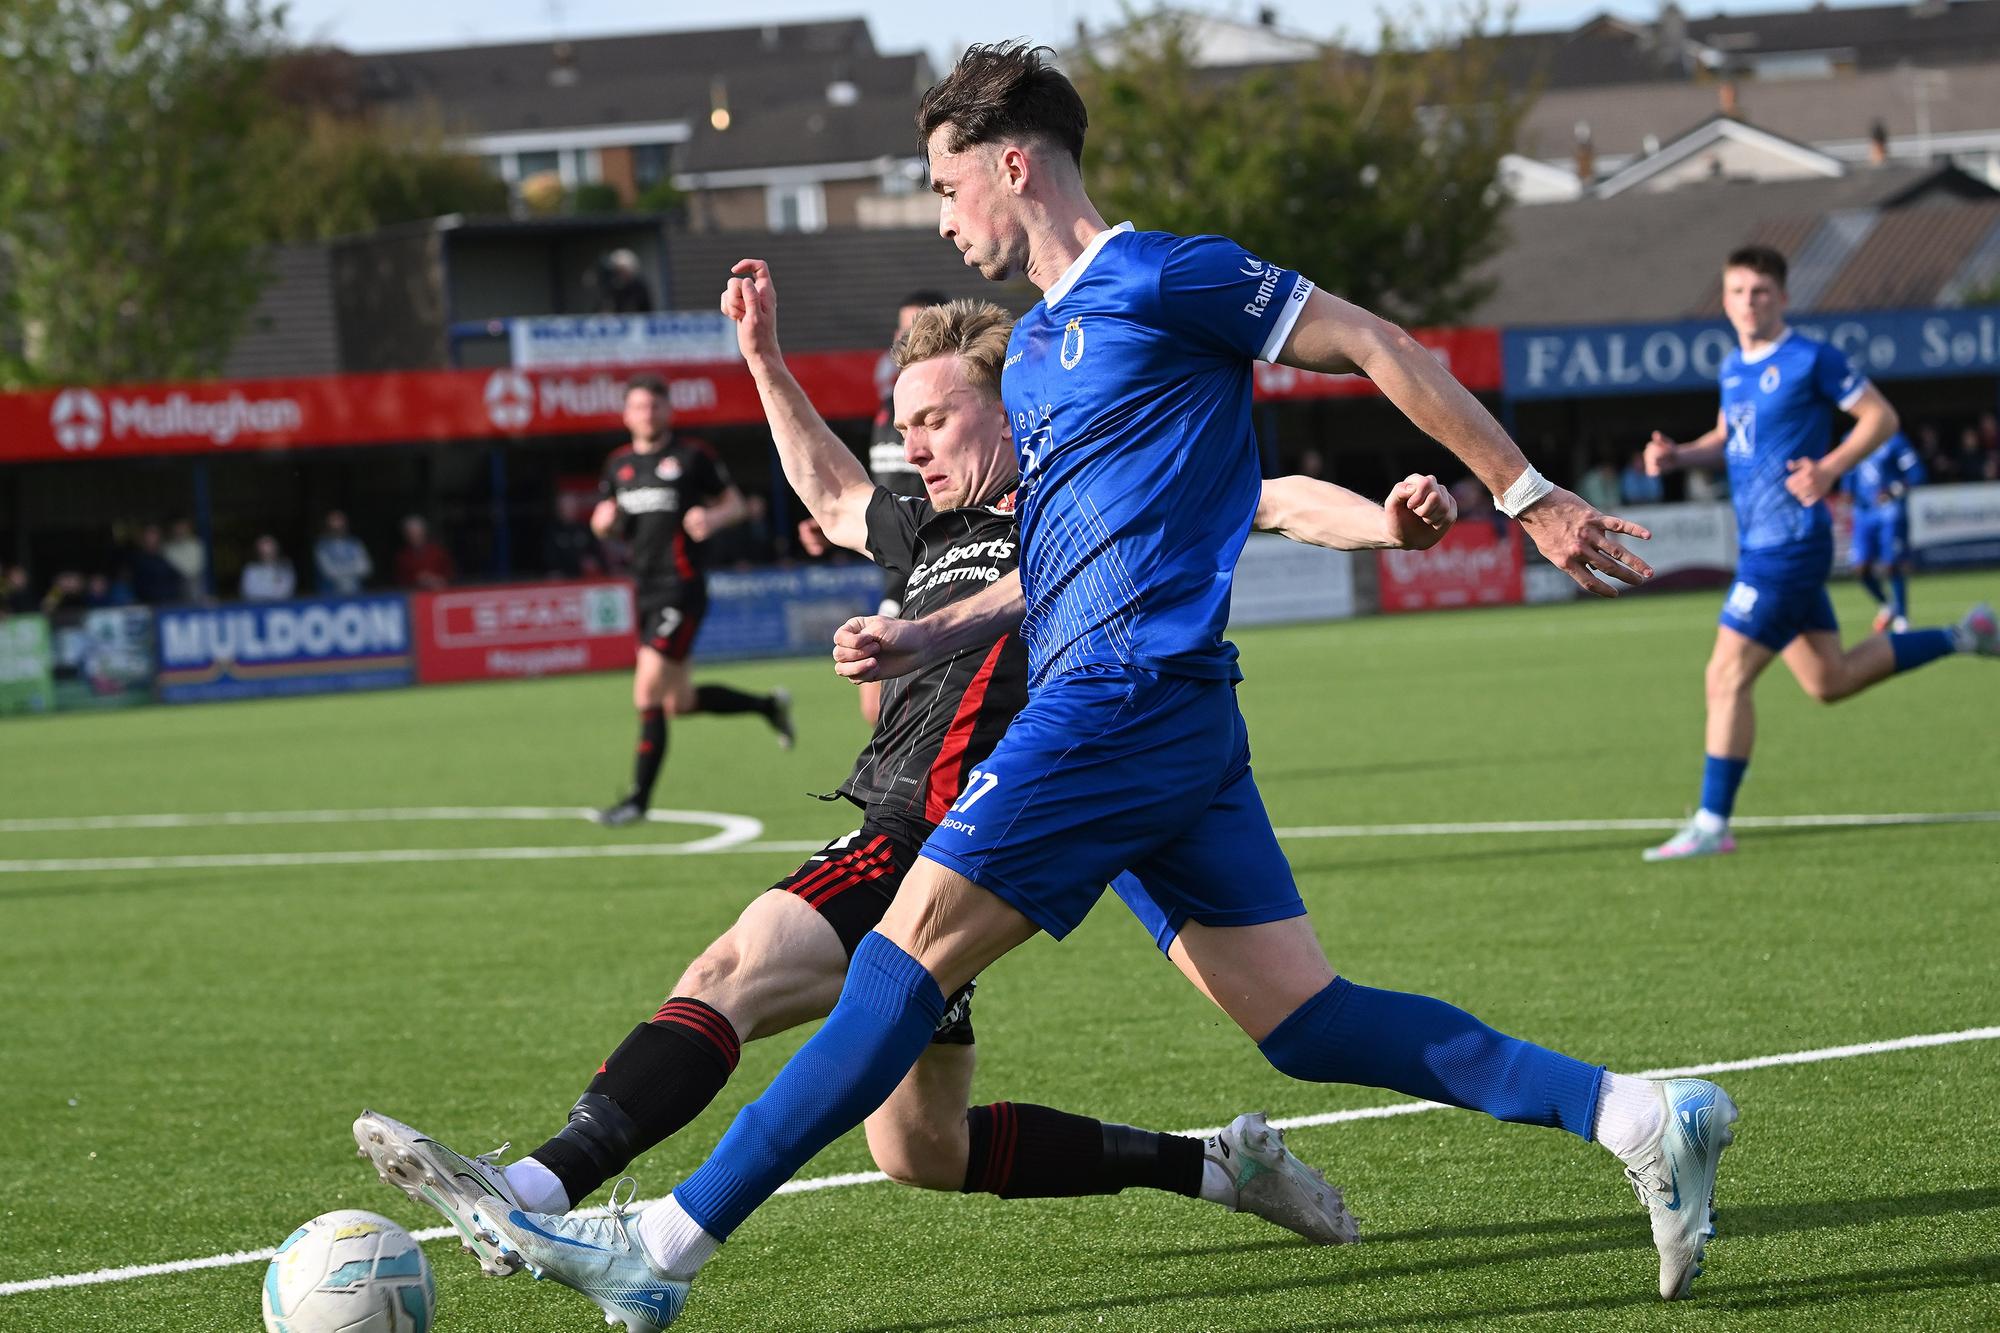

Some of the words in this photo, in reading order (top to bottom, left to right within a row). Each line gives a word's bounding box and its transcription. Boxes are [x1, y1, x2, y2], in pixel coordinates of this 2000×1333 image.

[1243, 264, 1287, 318] Rams
[1526, 328, 1736, 388] FALOO
[1921, 314, 2000, 368] Sol
[110, 391, 302, 446] Mallaghan
[161, 602, 405, 666] MULDOON
